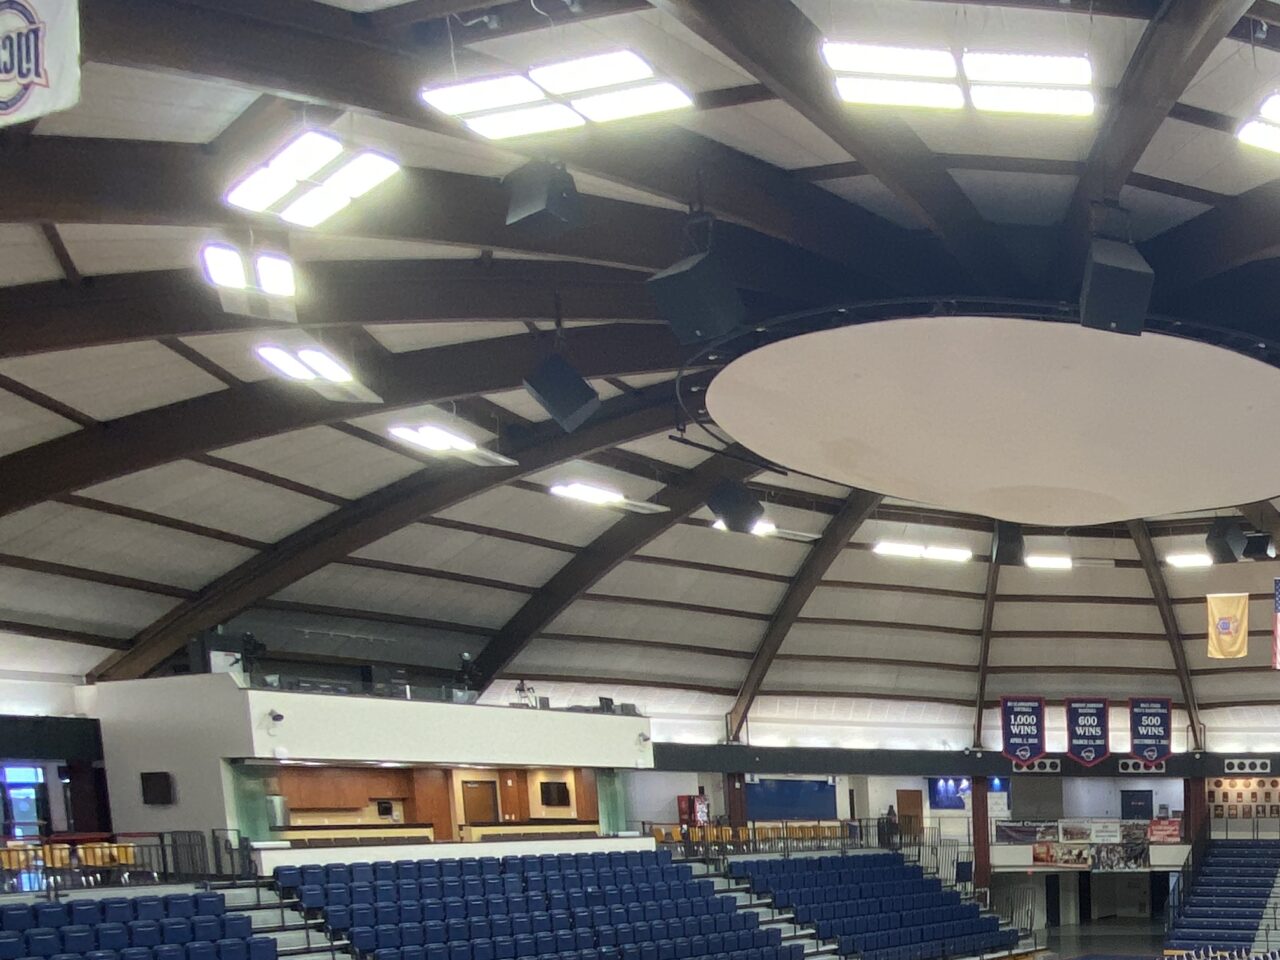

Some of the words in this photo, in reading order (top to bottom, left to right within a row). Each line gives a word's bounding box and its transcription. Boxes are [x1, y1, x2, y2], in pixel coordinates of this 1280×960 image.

[1010, 715, 1037, 725] 1,000
[1078, 716, 1097, 725] 600
[1141, 716, 1160, 725] 500
[1010, 725, 1037, 735] WINS
[1075, 727, 1101, 735] WINS
[1138, 727, 1164, 735] WINS
